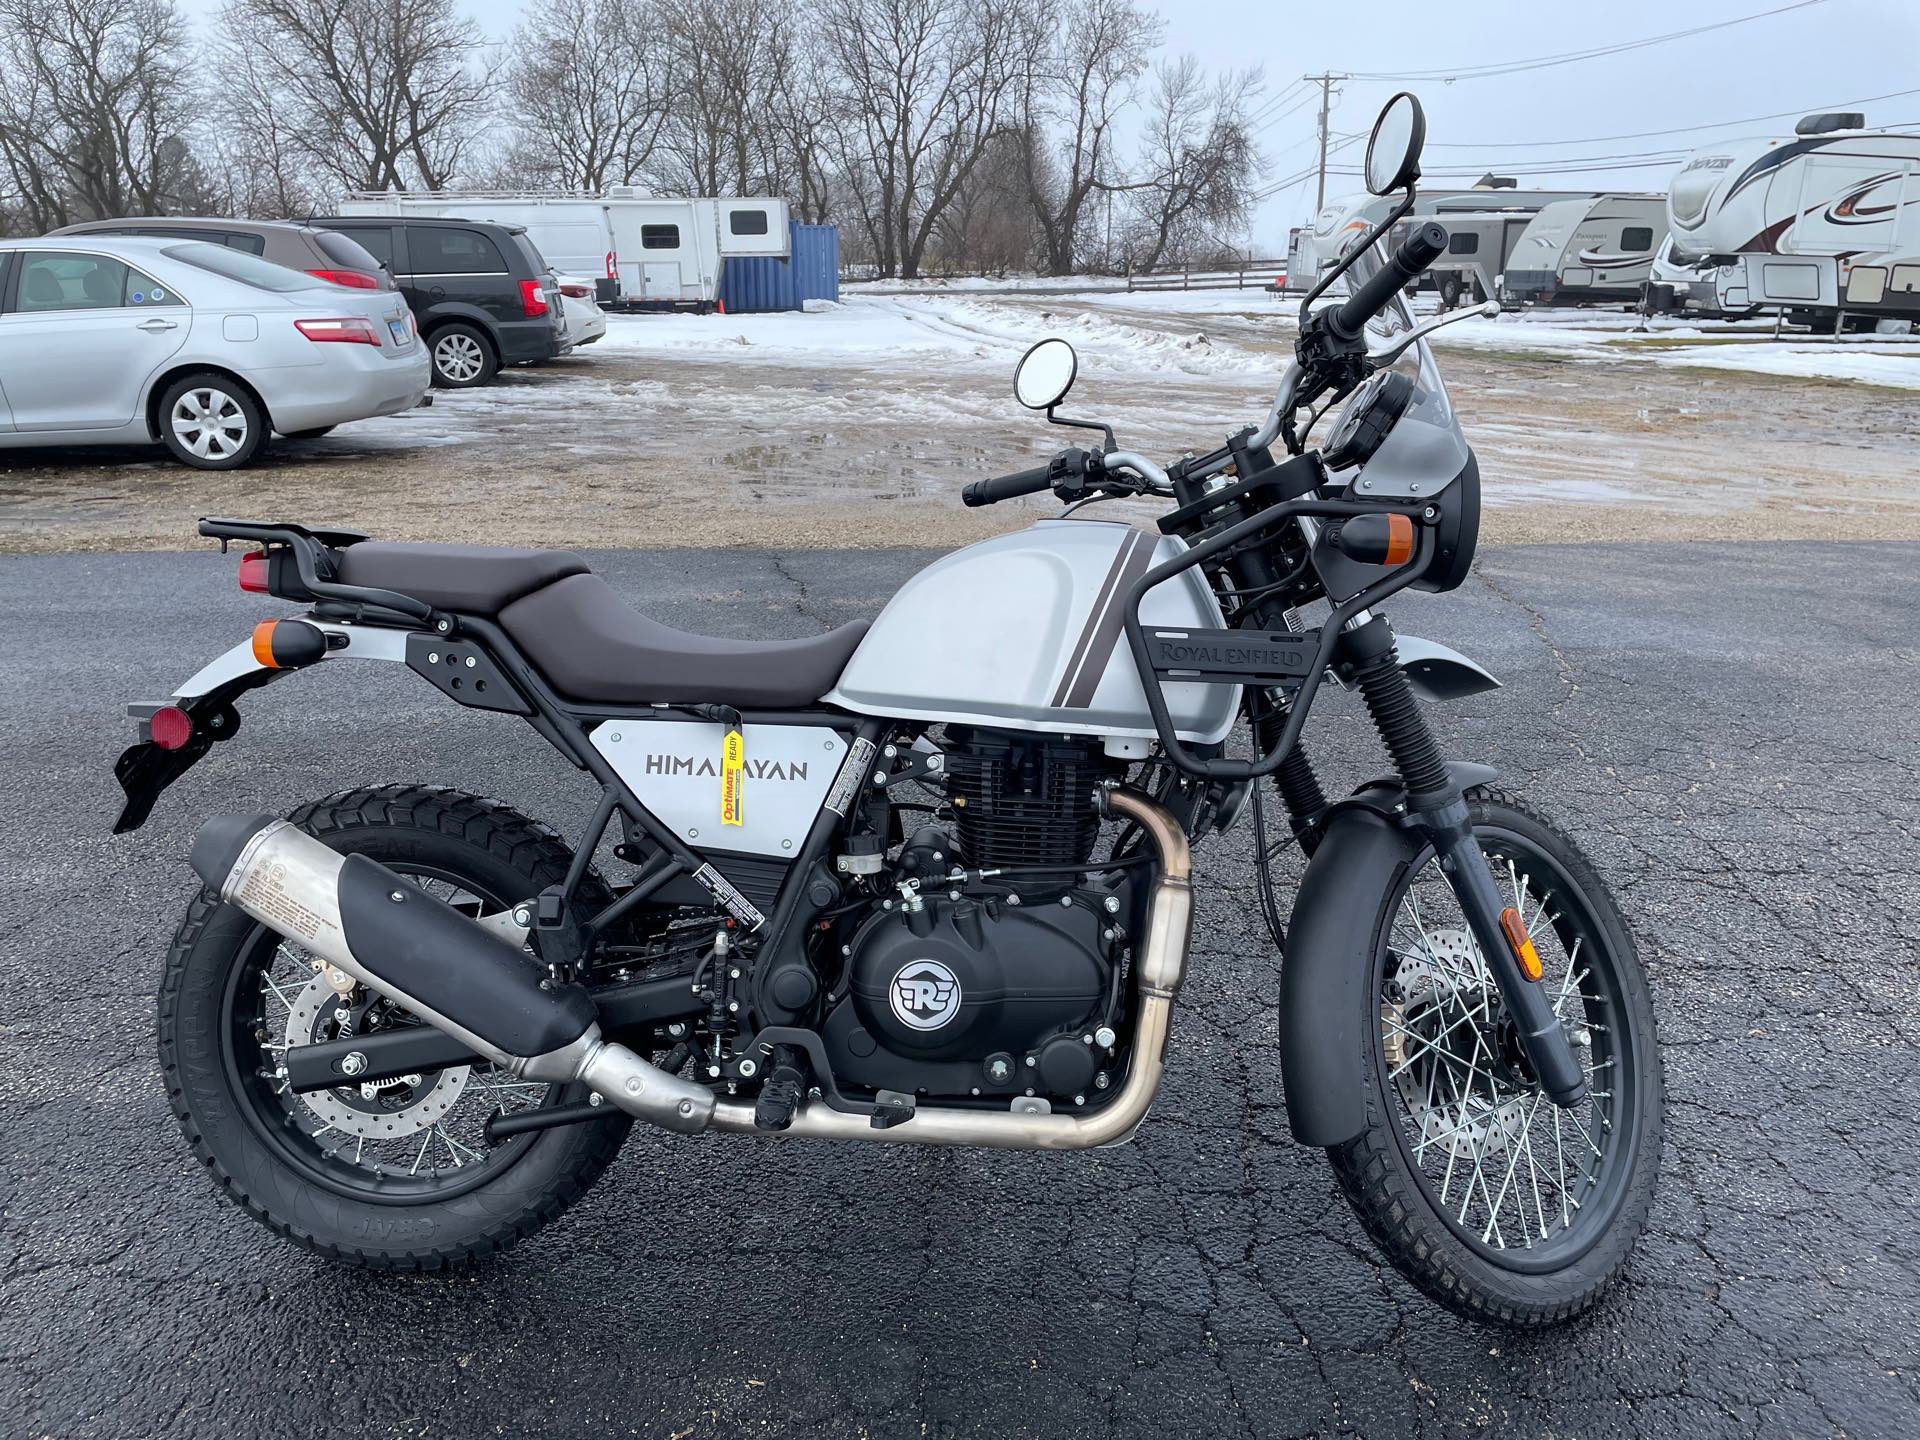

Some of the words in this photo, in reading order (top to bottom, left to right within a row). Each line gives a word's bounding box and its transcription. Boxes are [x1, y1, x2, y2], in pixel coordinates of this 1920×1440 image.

[1159, 642, 1222, 662] ROYAL
[1225, 647, 1303, 667] ENFIELD
[729, 736, 737, 761] READY
